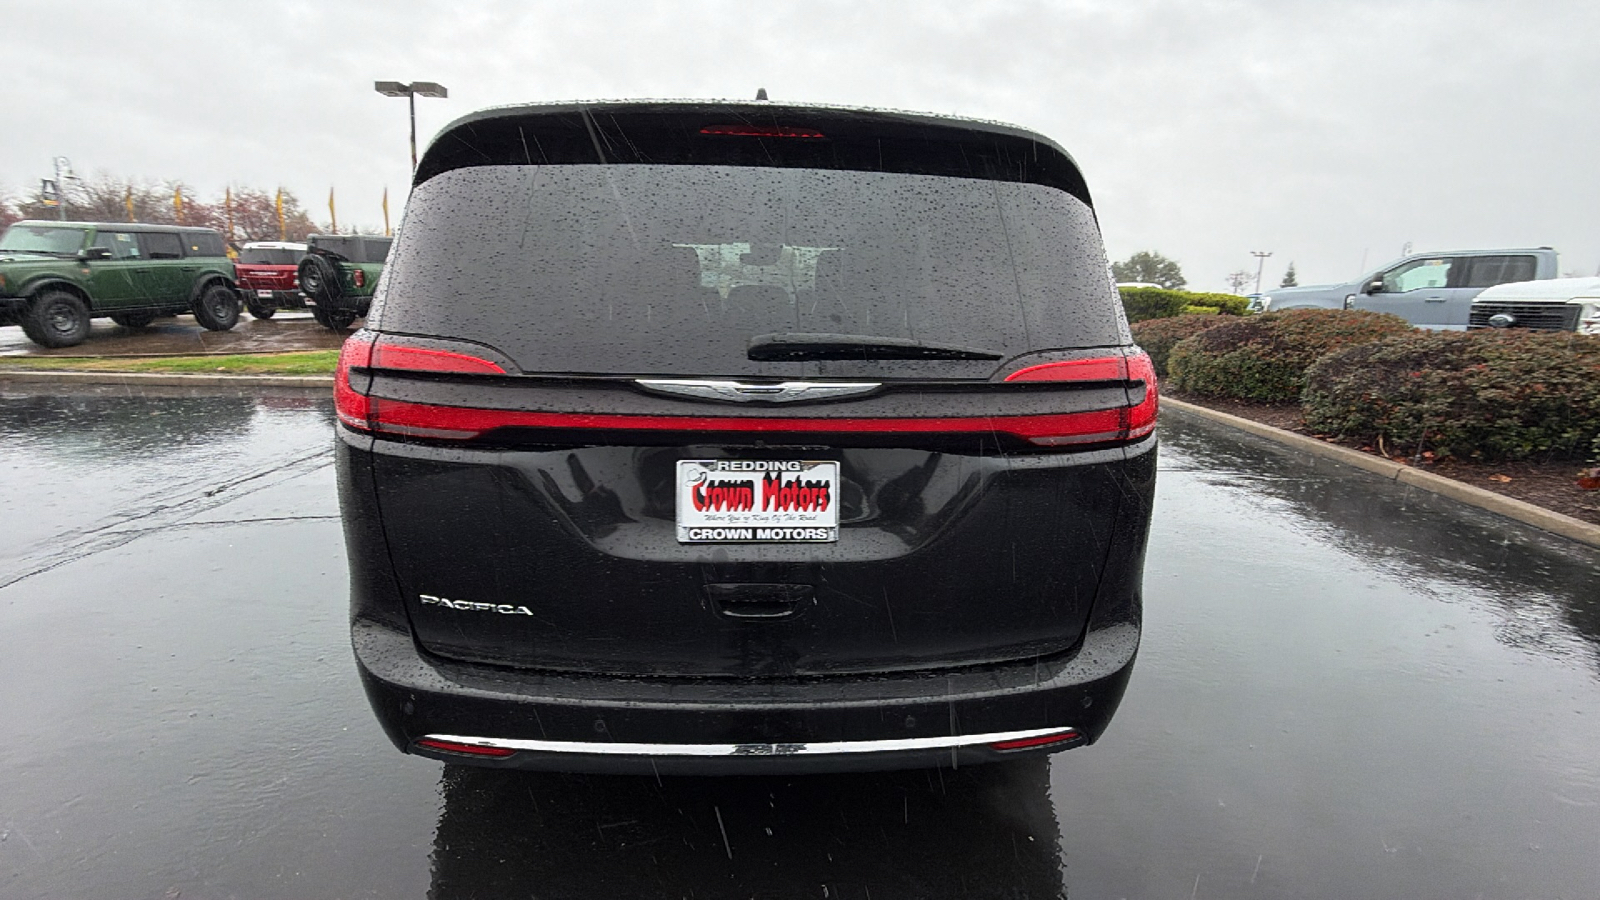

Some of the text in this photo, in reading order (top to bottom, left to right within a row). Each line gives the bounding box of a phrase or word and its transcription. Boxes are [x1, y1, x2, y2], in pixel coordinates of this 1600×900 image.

[717, 461, 800, 471] REDDING
[692, 473, 830, 512] Crown Motors
[689, 528, 828, 540] CROWN MOTORS
[419, 594, 534, 616] PACIFICA
